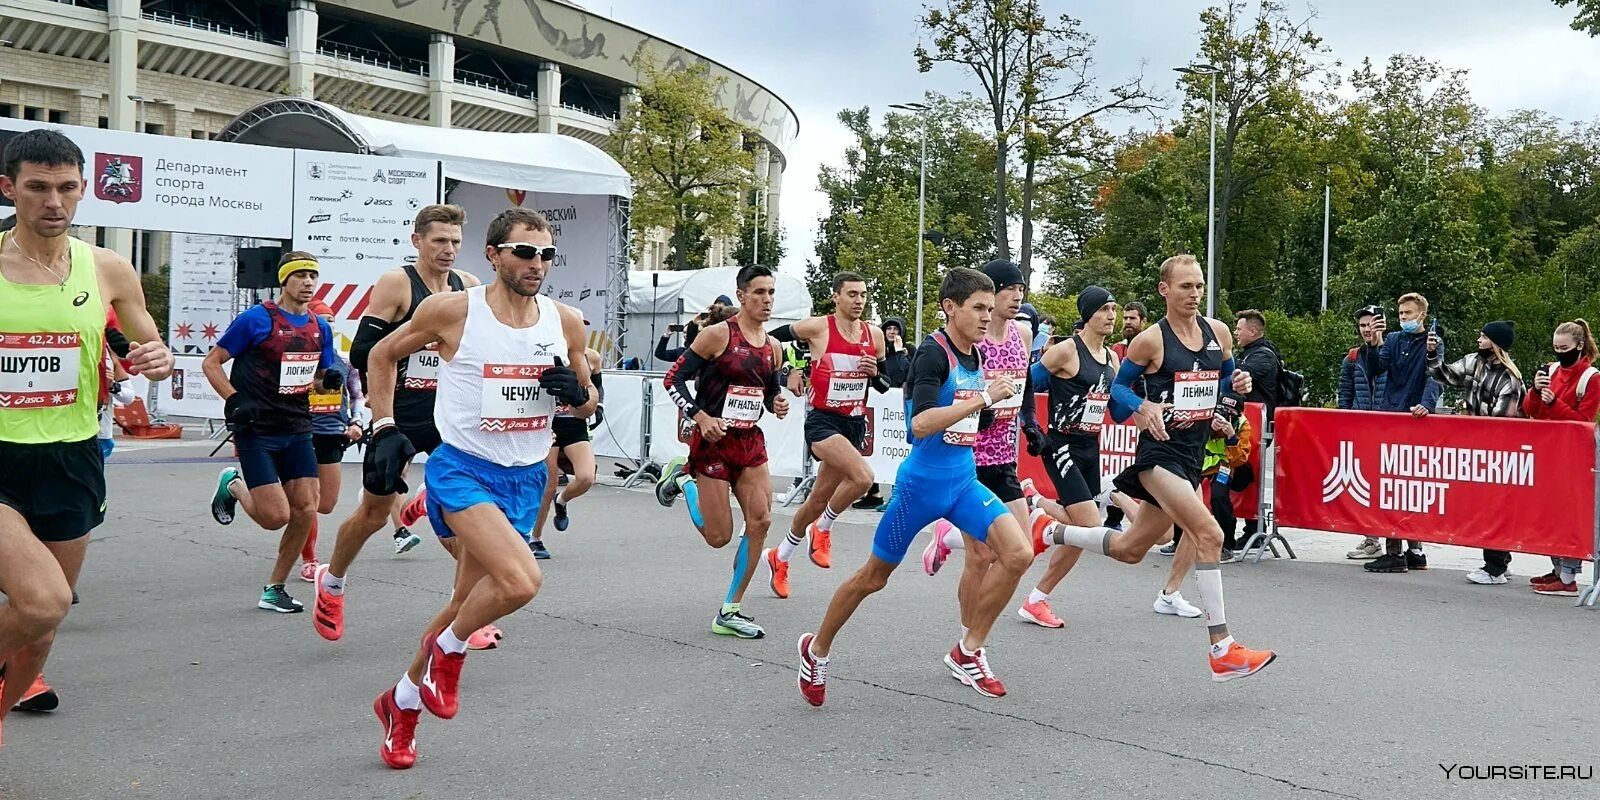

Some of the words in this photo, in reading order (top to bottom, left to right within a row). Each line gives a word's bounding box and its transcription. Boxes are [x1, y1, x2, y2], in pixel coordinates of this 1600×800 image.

[155, 158, 248, 178] Департамент
[388, 169, 427, 179] МОСКОВСКИЙ
[155, 177, 205, 191] спорта
[387, 177, 406, 185] СПОРТ
[155, 193, 205, 207] города
[208, 195, 263, 211] Москвы
[373, 198, 393, 206] asics
[537, 205, 577, 222] ОВСКИЙ
[361, 237, 386, 245] РОССИИ
[28, 335, 54, 346] 42,2
[1, 356, 61, 373] ШУТОВ
[419, 355, 440, 368] ЧАВ
[519, 367, 539, 377] 42,2
[502, 386, 540, 401] ЧЕЧУН
[833, 382, 864, 392] ШИРШОВ
[1182, 384, 1215, 398] ЛЕЙМАН
[24, 396, 46, 404] asics
[1100, 423, 1140, 454] МОС
[1099, 454, 1136, 478] СПО
[1380, 443, 1535, 487] МОСКОВСКИЙ
[1379, 477, 1450, 515] СПОРТ
